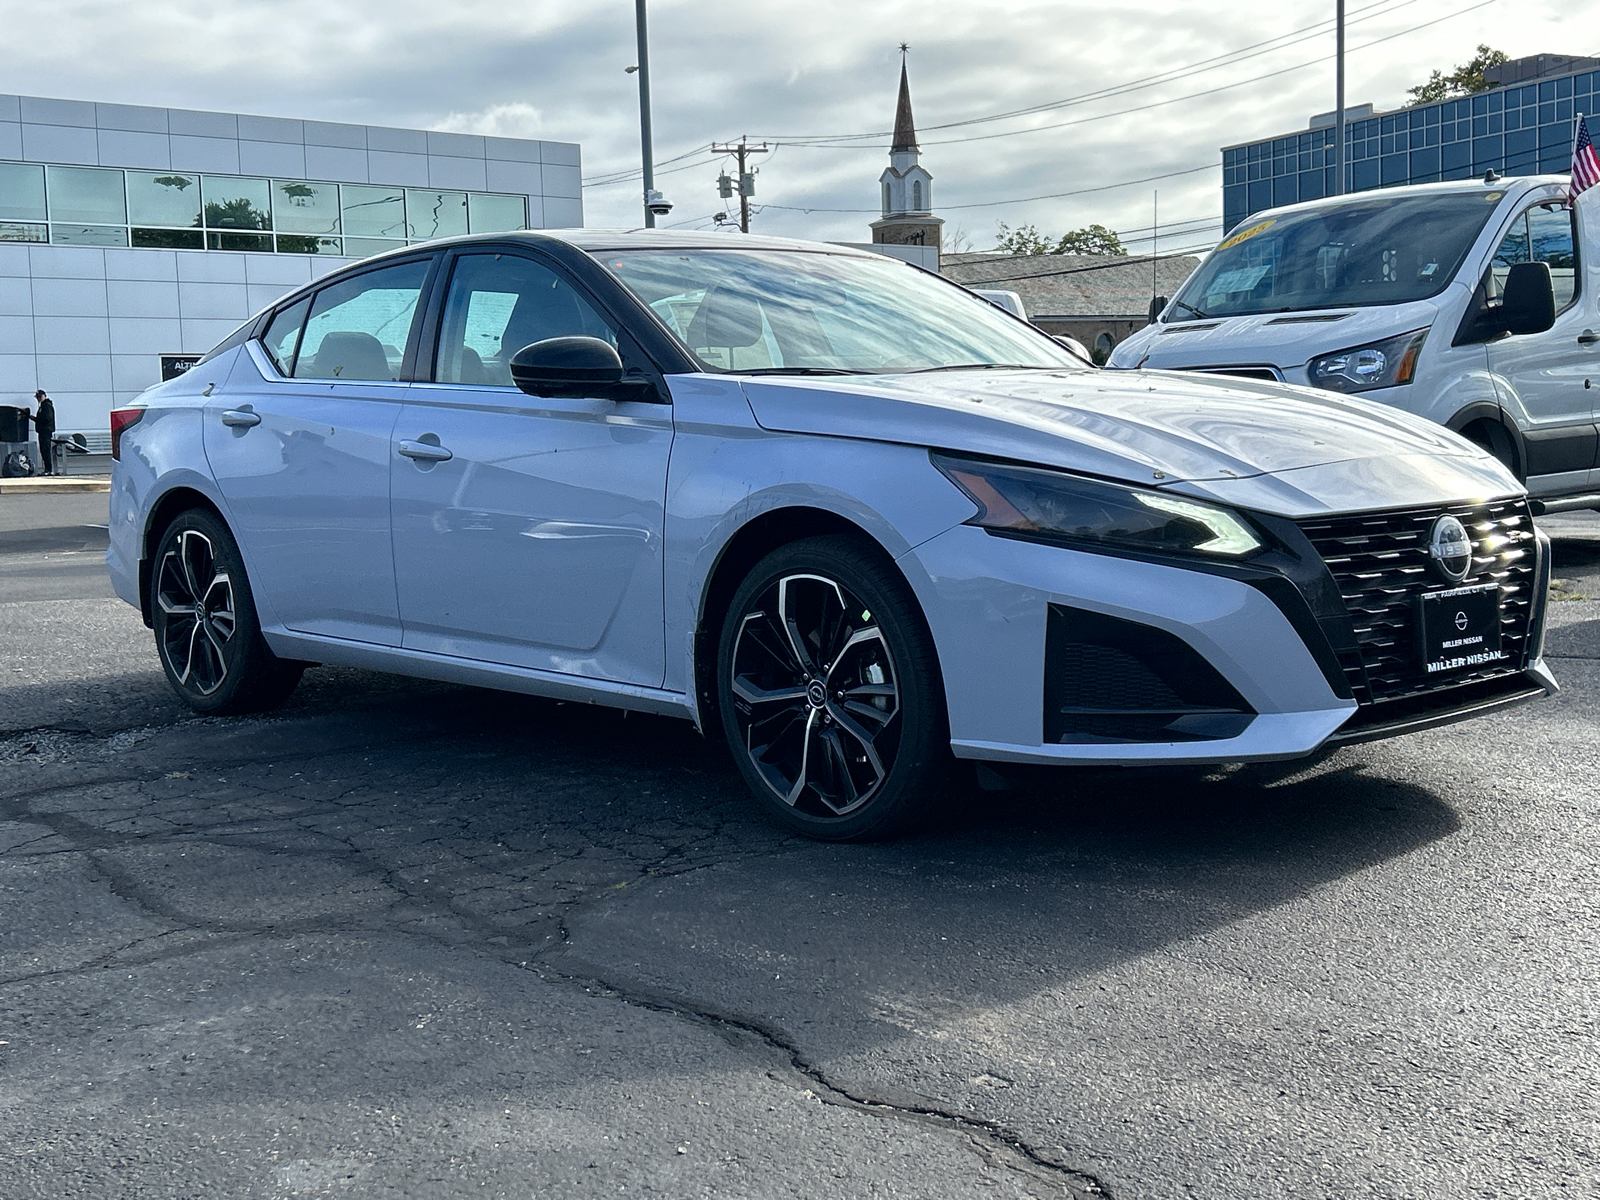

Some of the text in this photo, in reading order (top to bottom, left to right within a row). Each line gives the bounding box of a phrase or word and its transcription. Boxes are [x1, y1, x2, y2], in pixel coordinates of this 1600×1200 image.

[1227, 223, 1267, 248] 2025
[174, 361, 197, 370] ALTI
[1431, 544, 1467, 557] NISS
[1442, 635, 1483, 649] MILLER NISSAN
[1427, 650, 1501, 672] MILLER NISSAN
